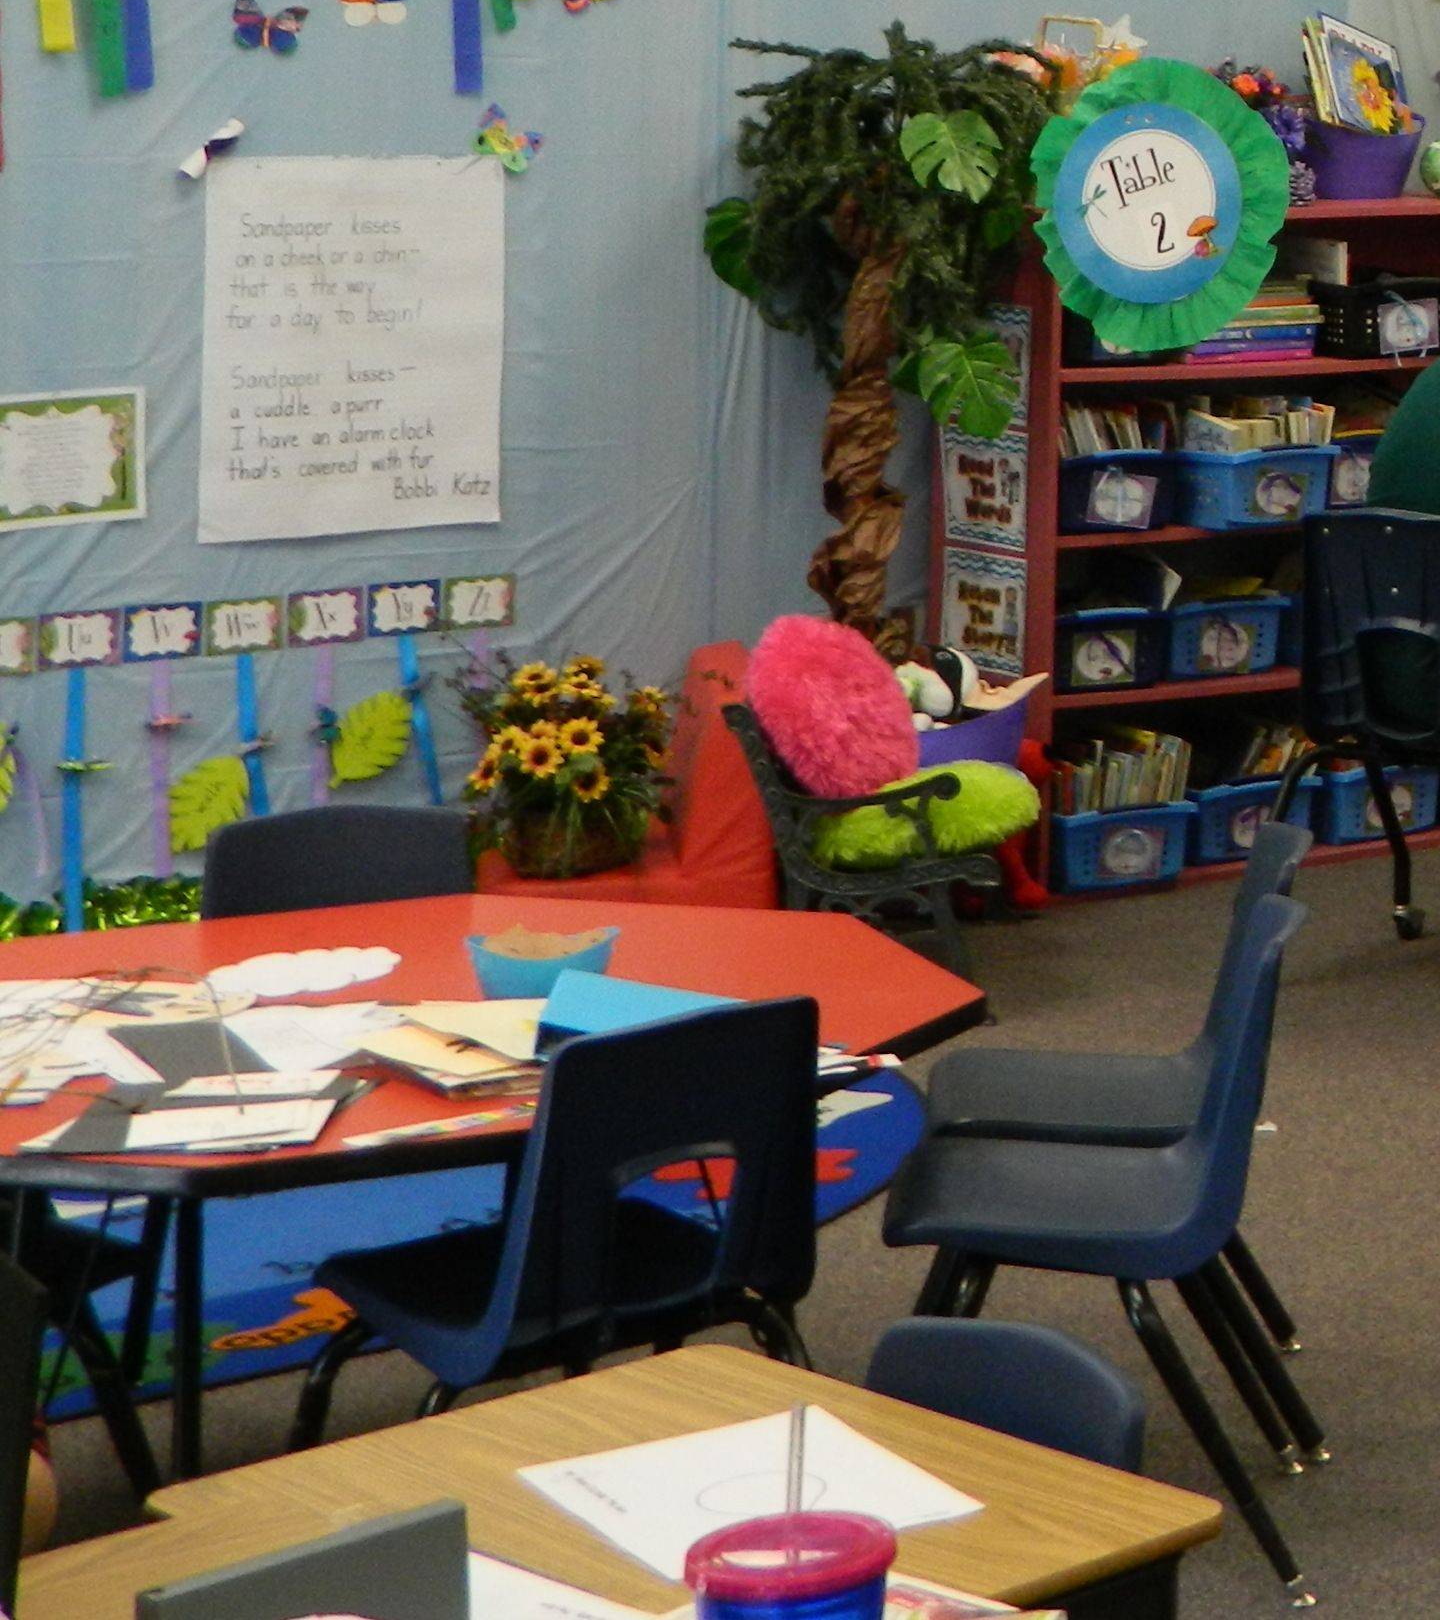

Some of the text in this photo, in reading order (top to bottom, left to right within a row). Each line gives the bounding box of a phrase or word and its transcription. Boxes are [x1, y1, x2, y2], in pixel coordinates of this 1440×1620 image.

[1101, 148, 1175, 210] Table
[1151, 212, 1175, 254] 2
[229, 275, 269, 298] that
[310, 274, 338, 296] the
[225, 304, 255, 329] for
[290, 303, 323, 334] day
[335, 302, 356, 325] to
[230, 417, 435, 451] I have an alarm clock
[299, 448, 359, 478] covered
[370, 452, 401, 473] with
[410, 445, 434, 470] fur
